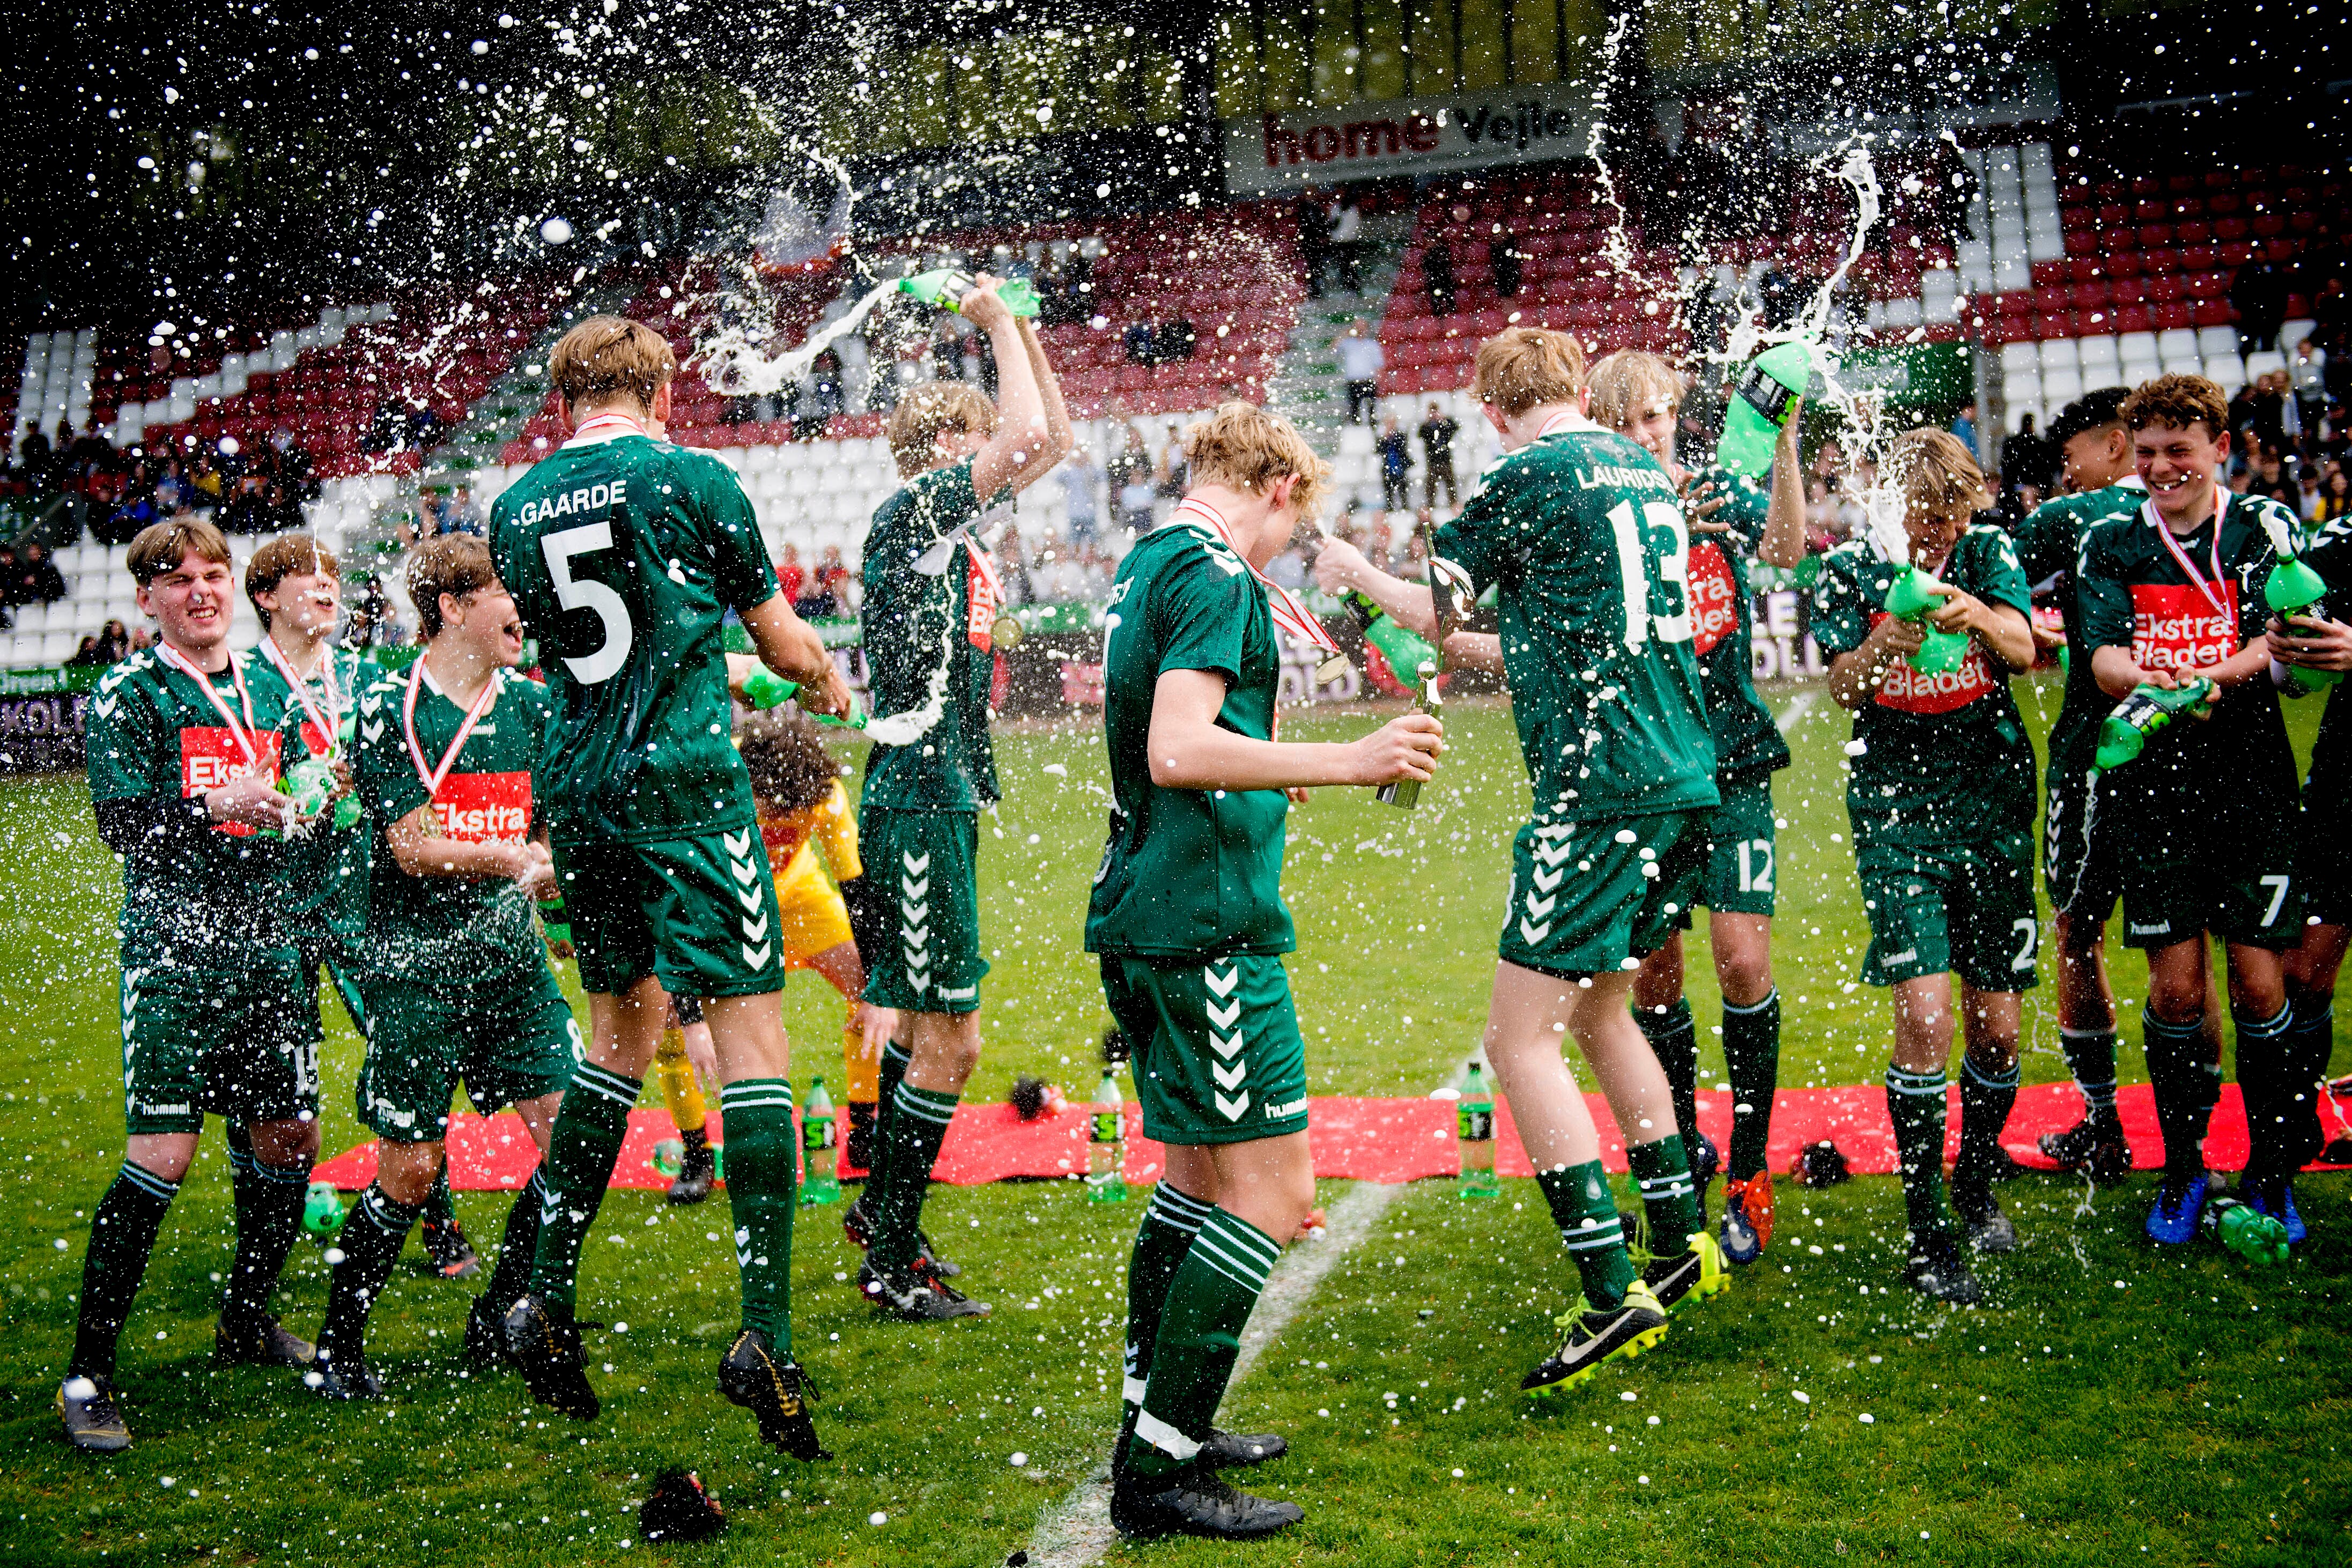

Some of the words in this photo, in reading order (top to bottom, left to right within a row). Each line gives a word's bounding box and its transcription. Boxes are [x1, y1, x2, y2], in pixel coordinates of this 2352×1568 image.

[1261, 109, 1441, 167] home
[1452, 100, 1575, 151] Vejle
[521, 480, 627, 526] GAARDE
[1605, 499, 1693, 644] 13
[541, 521, 632, 685] 5
[2133, 613, 2233, 641] Ekstra
[189, 756, 275, 786] Eksa
[430, 803, 527, 832] Ekstra
[1737, 838, 1773, 893] 12
[2259, 875, 2289, 927] 7
[2013, 918, 2037, 970] 2
[2130, 919, 2171, 935] hummel
[566, 1018, 588, 1063] 8
[143, 1100, 190, 1115] hummel
